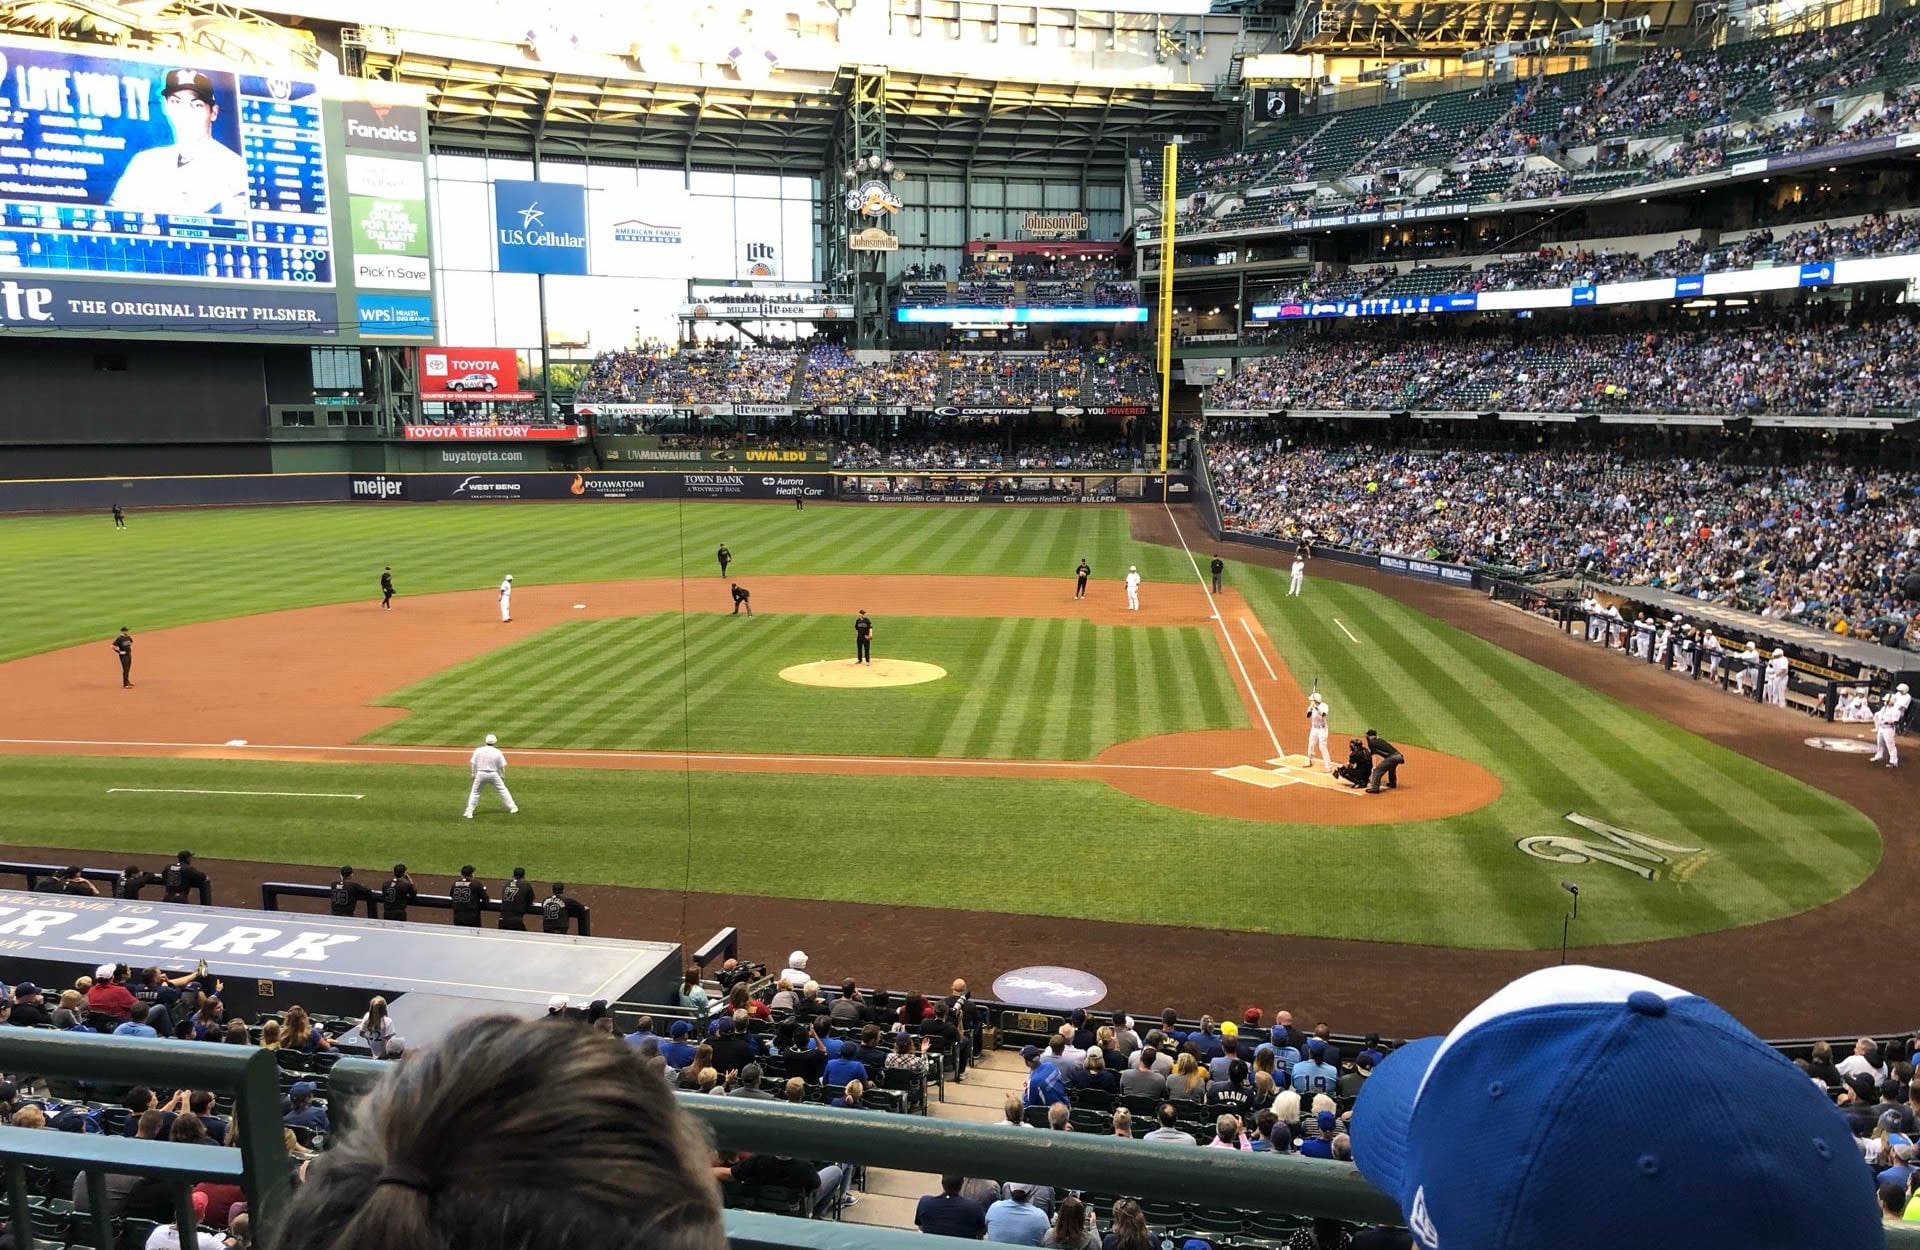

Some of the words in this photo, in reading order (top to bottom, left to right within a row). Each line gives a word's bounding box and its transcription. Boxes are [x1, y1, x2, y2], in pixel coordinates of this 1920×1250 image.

[73, 71, 121, 118] YOU
[122, 76, 151, 121] TY
[347, 119, 417, 142] Fanatics
[1021, 212, 1088, 230] Johnsonville
[500, 229, 526, 245] U.S.
[527, 231, 586, 248] Cellular
[615, 228, 653, 236] AMERICAN
[852, 236, 897, 249] Johnsonville
[747, 242, 774, 262] Lite
[360, 266, 384, 277] Pick
[397, 268, 426, 279] Save
[68, 300, 107, 314] THE
[111, 302, 194, 317] ORIGINAL
[198, 305, 248, 320] LIGHT
[253, 308, 321, 322] PILSNER.
[361, 308, 391, 321] WPS
[727, 306, 758, 314] MILLER
[782, 306, 804, 314] DECK
[451, 361, 500, 370] TOYOTA
[407, 427, 458, 437] TOYOTA
[461, 427, 529, 438] TERRITORY
[442, 450, 522, 462] buyatoyota.com
[746, 451, 807, 461] UWM.EDU
[684, 475, 714, 483] TOWN
[716, 475, 744, 485] BANK
[776, 477, 803, 485] Aurora
[353, 476, 402, 498] meijer
[776, 487, 802, 495] Health
[803, 487, 822, 496] Care
[119, 905, 153, 914] TO
[544, 904, 560, 919] 12
[67, 916, 361, 961] PARK
[1304, 1075, 1327, 1092] 19
[1218, 1091, 1248, 1103] BRAUN
